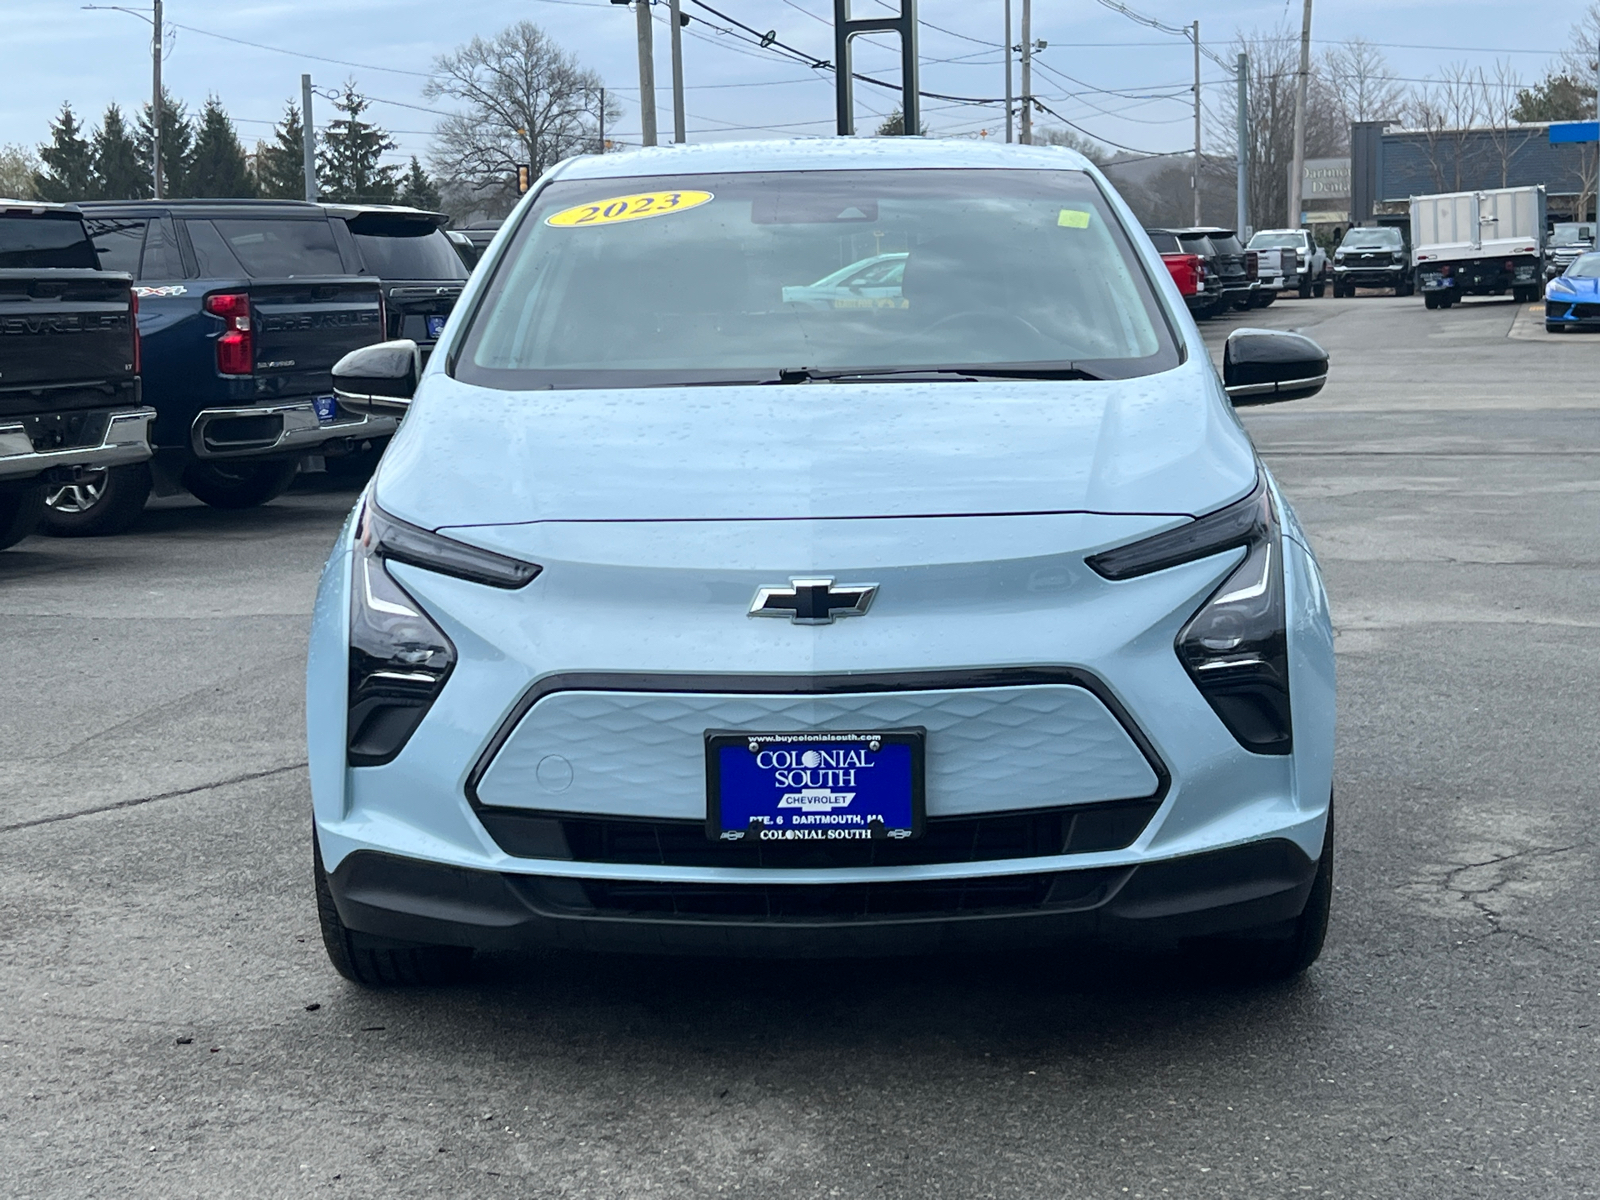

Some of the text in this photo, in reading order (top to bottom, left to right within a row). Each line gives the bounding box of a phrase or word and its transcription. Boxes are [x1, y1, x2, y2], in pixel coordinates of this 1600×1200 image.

[575, 193, 682, 225] 2023
[0, 315, 126, 335] EVROLET
[748, 734, 881, 744] www.buycolonialsouth.com
[775, 769, 857, 788] SOUTH
[785, 796, 848, 805] CHEVROLET
[776, 815, 784, 825] 6
[792, 814, 865, 826] DARTMOUTH,
[867, 814, 885, 824] MA
[827, 829, 872, 839] SOUTH
